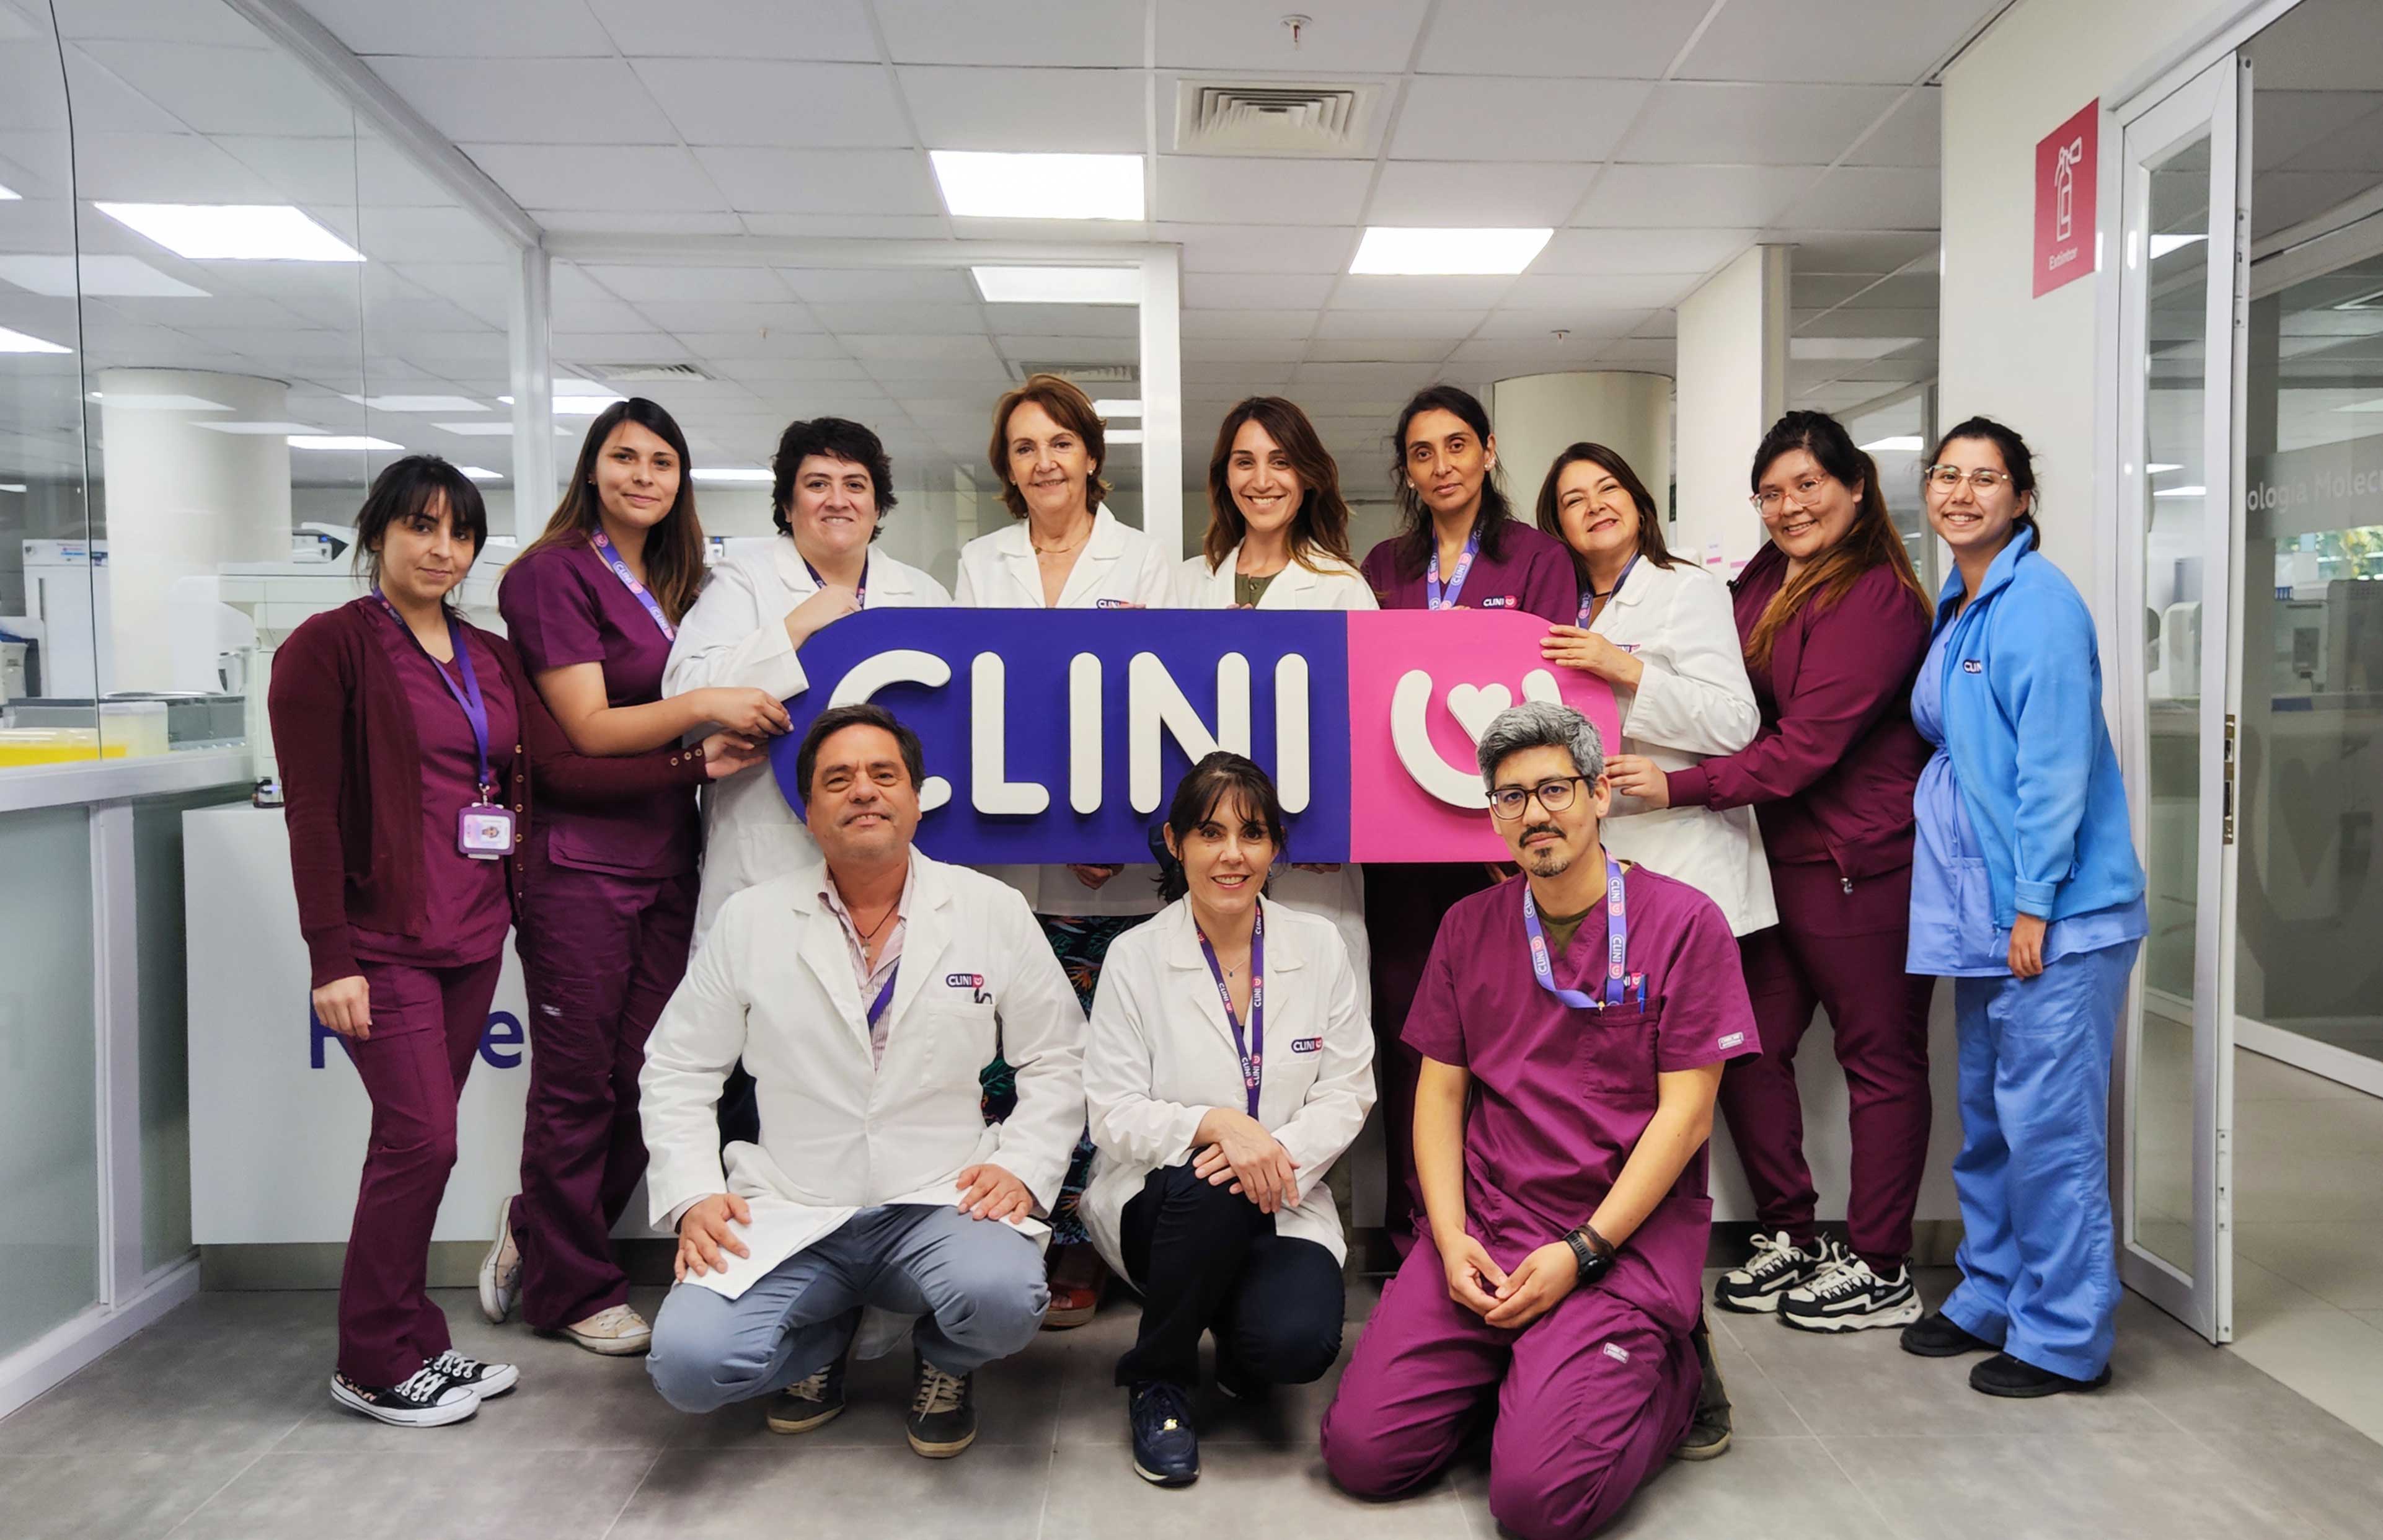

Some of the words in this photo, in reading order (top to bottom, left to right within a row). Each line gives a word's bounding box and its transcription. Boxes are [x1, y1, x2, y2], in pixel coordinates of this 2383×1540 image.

[1452, 564, 1467, 583] CLINI
[1483, 598, 1505, 607] CLINI
[1611, 880, 1620, 903] CLINI
[1612, 937, 1622, 963] CLINI
[1535, 951, 1547, 973] CLINI
[948, 975, 972, 986] CLINI
[1219, 983, 1229, 1002] CLINI
[1253, 988, 1262, 1007] CLINI
[1293, 1041, 1314, 1051] CLINI
[1241, 1057, 1252, 1078] CLINI
